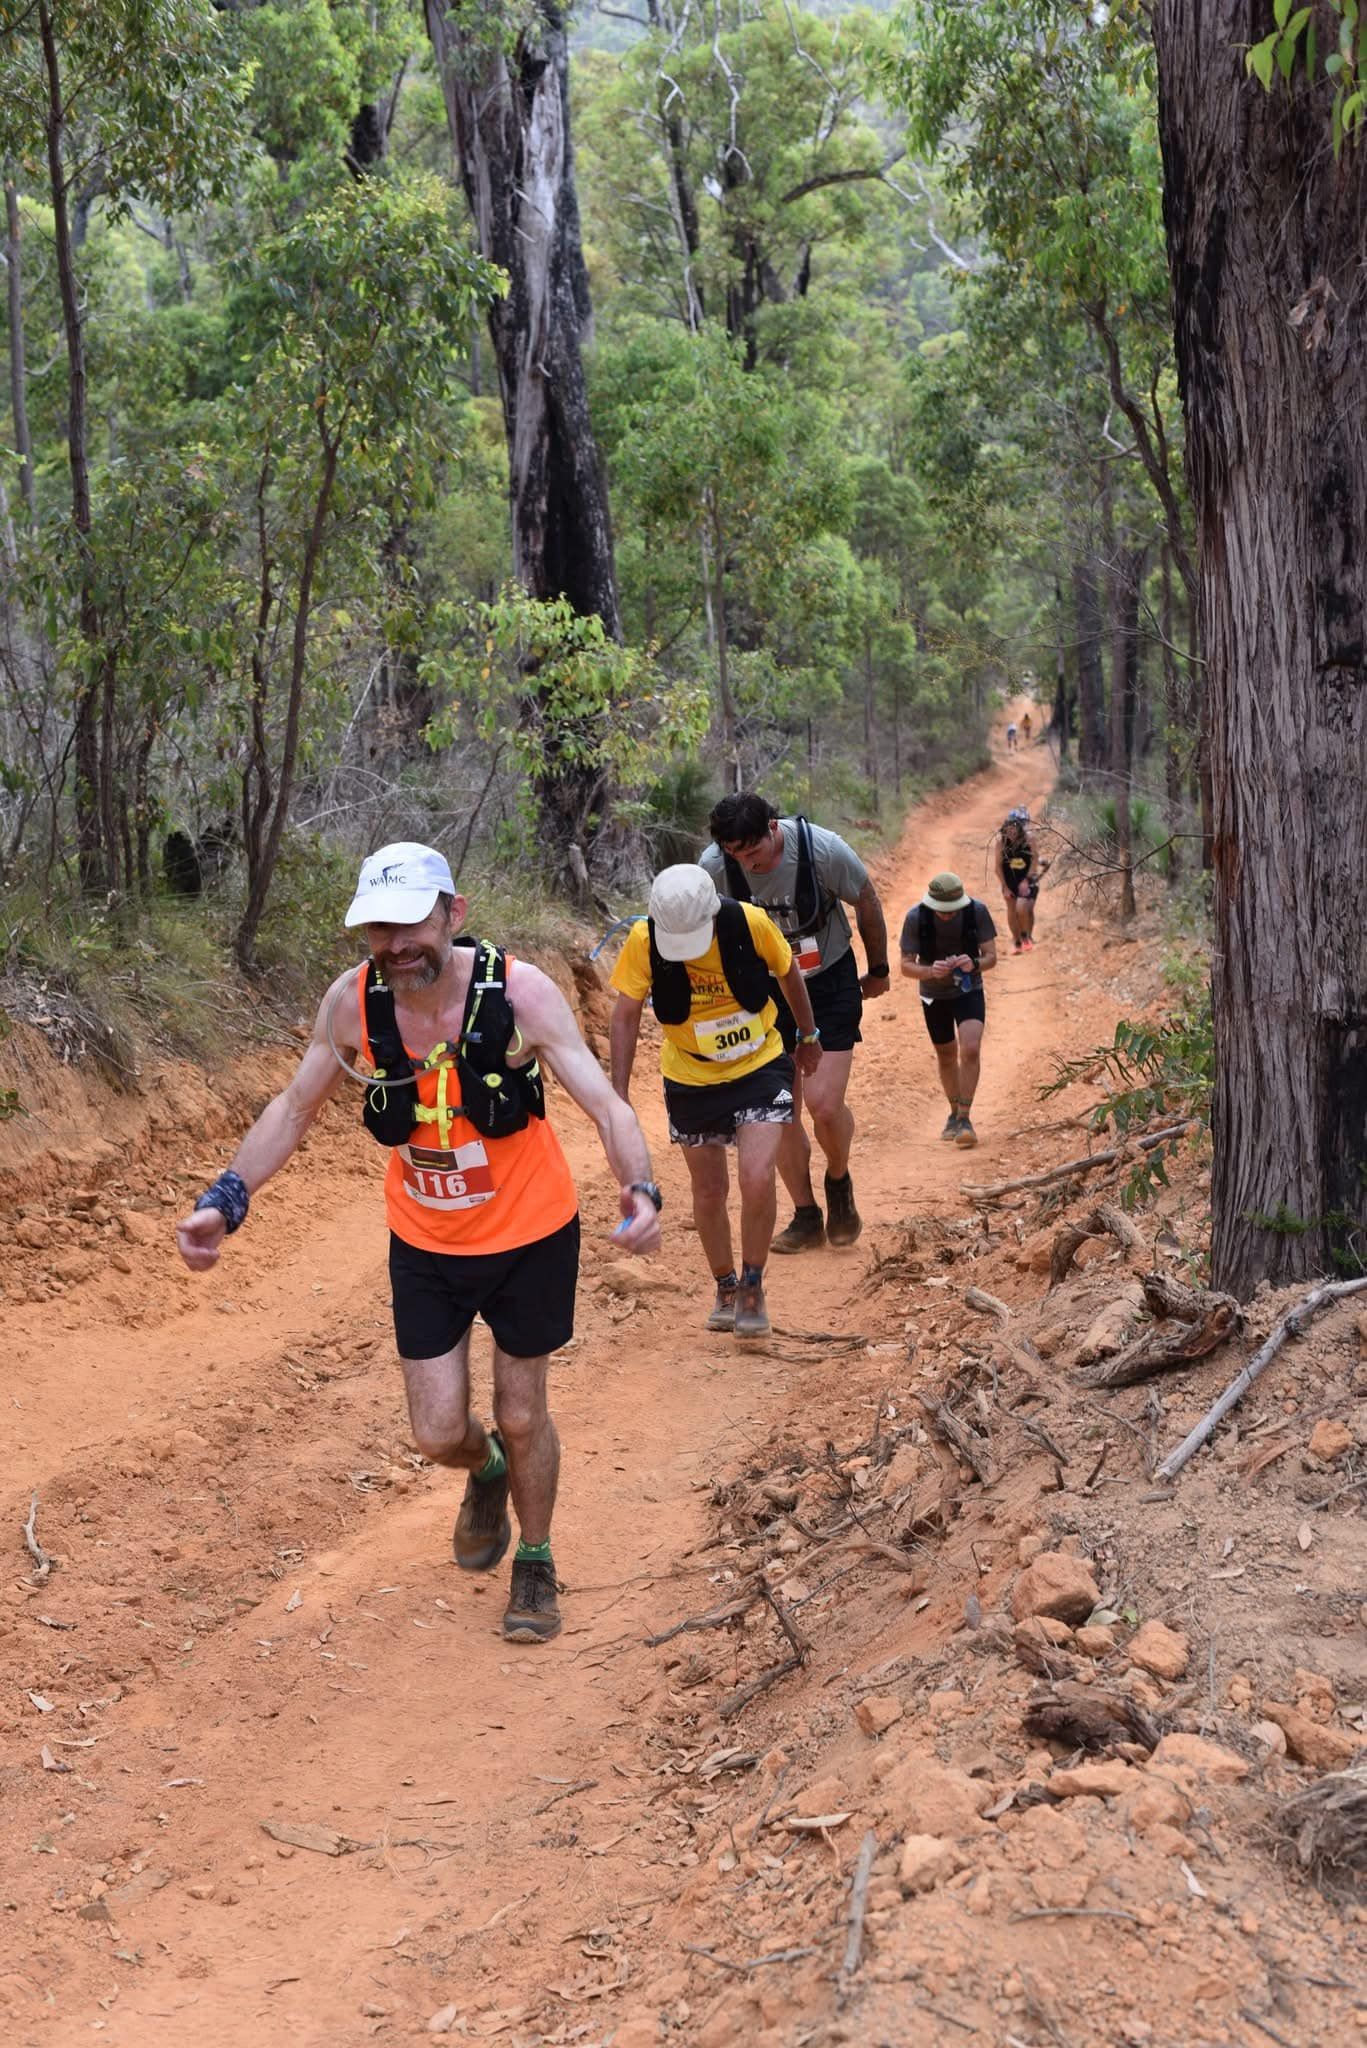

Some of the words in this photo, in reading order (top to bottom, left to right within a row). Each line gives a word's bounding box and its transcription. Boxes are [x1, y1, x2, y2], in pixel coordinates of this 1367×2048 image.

[689, 974, 724, 985] RAIL
[690, 984, 725, 995] ATHON
[714, 1026, 751, 1050] 300
[413, 1171, 467, 1198] 116
